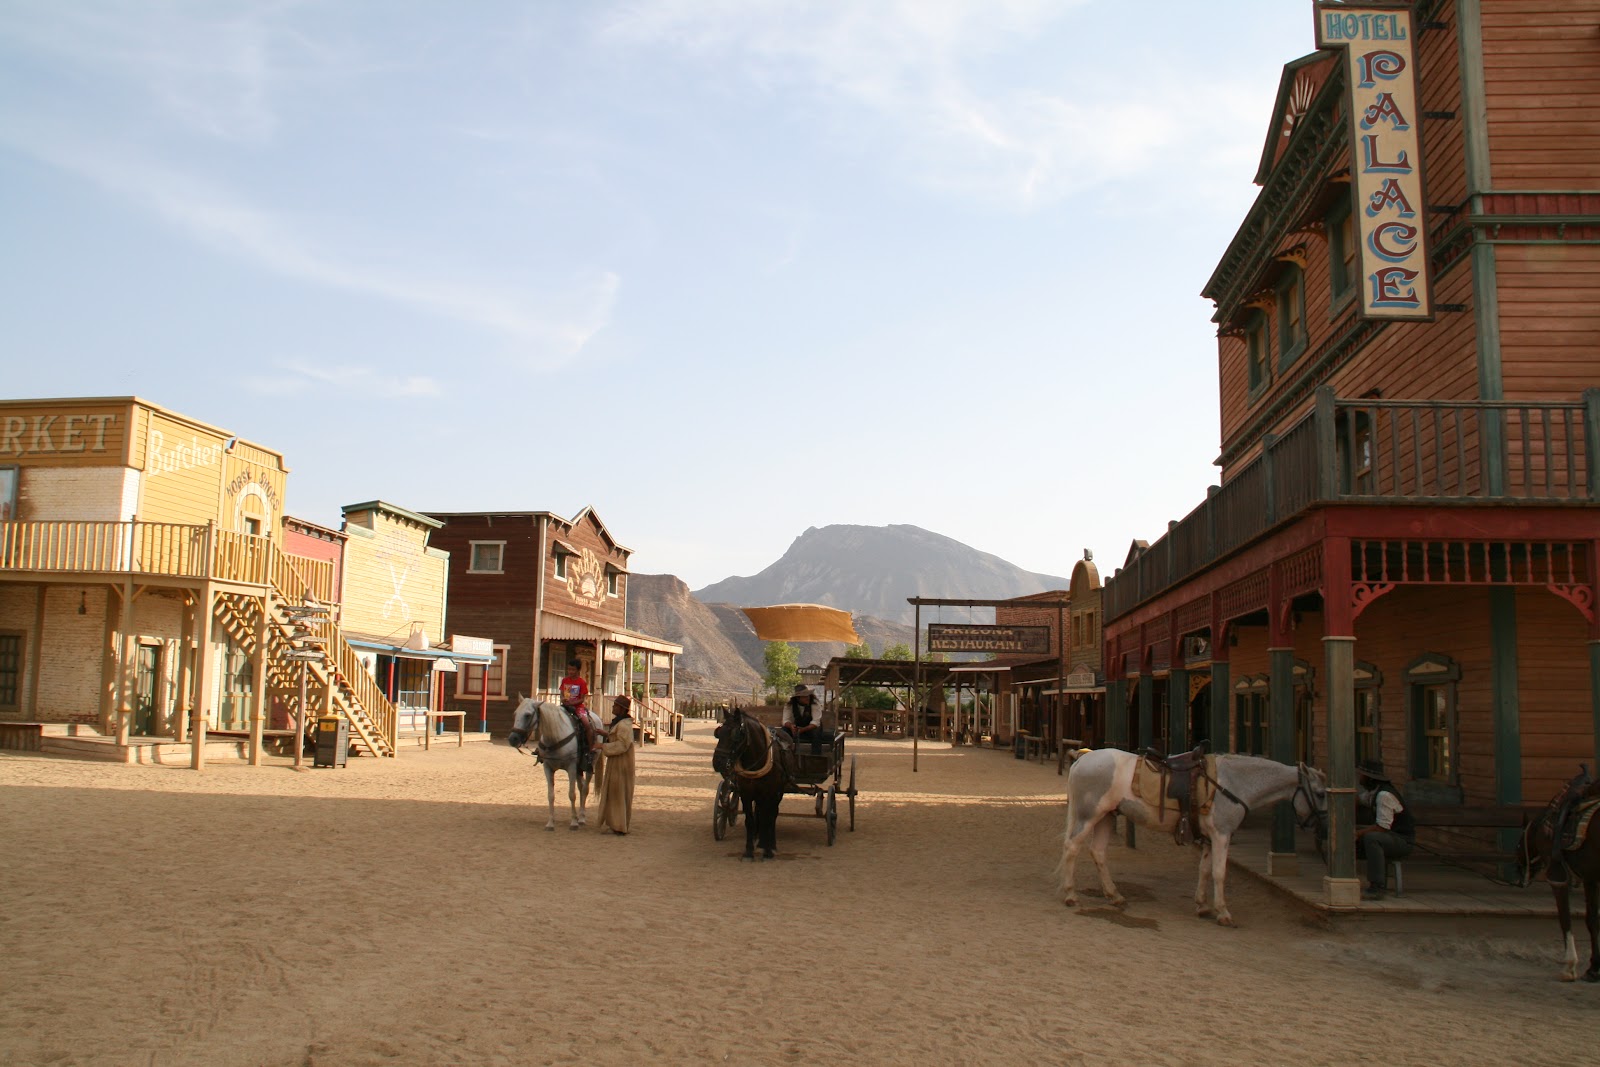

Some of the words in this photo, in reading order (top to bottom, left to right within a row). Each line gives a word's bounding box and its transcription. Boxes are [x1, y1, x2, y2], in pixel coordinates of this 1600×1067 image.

[1325, 12, 1407, 41] HOTEL
[1357, 50, 1421, 309] PALACE
[0, 414, 117, 457] RKET
[148, 429, 222, 477] Butcher
[226, 467, 253, 498] HORSE
[259, 472, 280, 511] SHOES
[931, 633, 1024, 650] RESTAURANT
[942, 626, 1013, 635] ARIZONA
